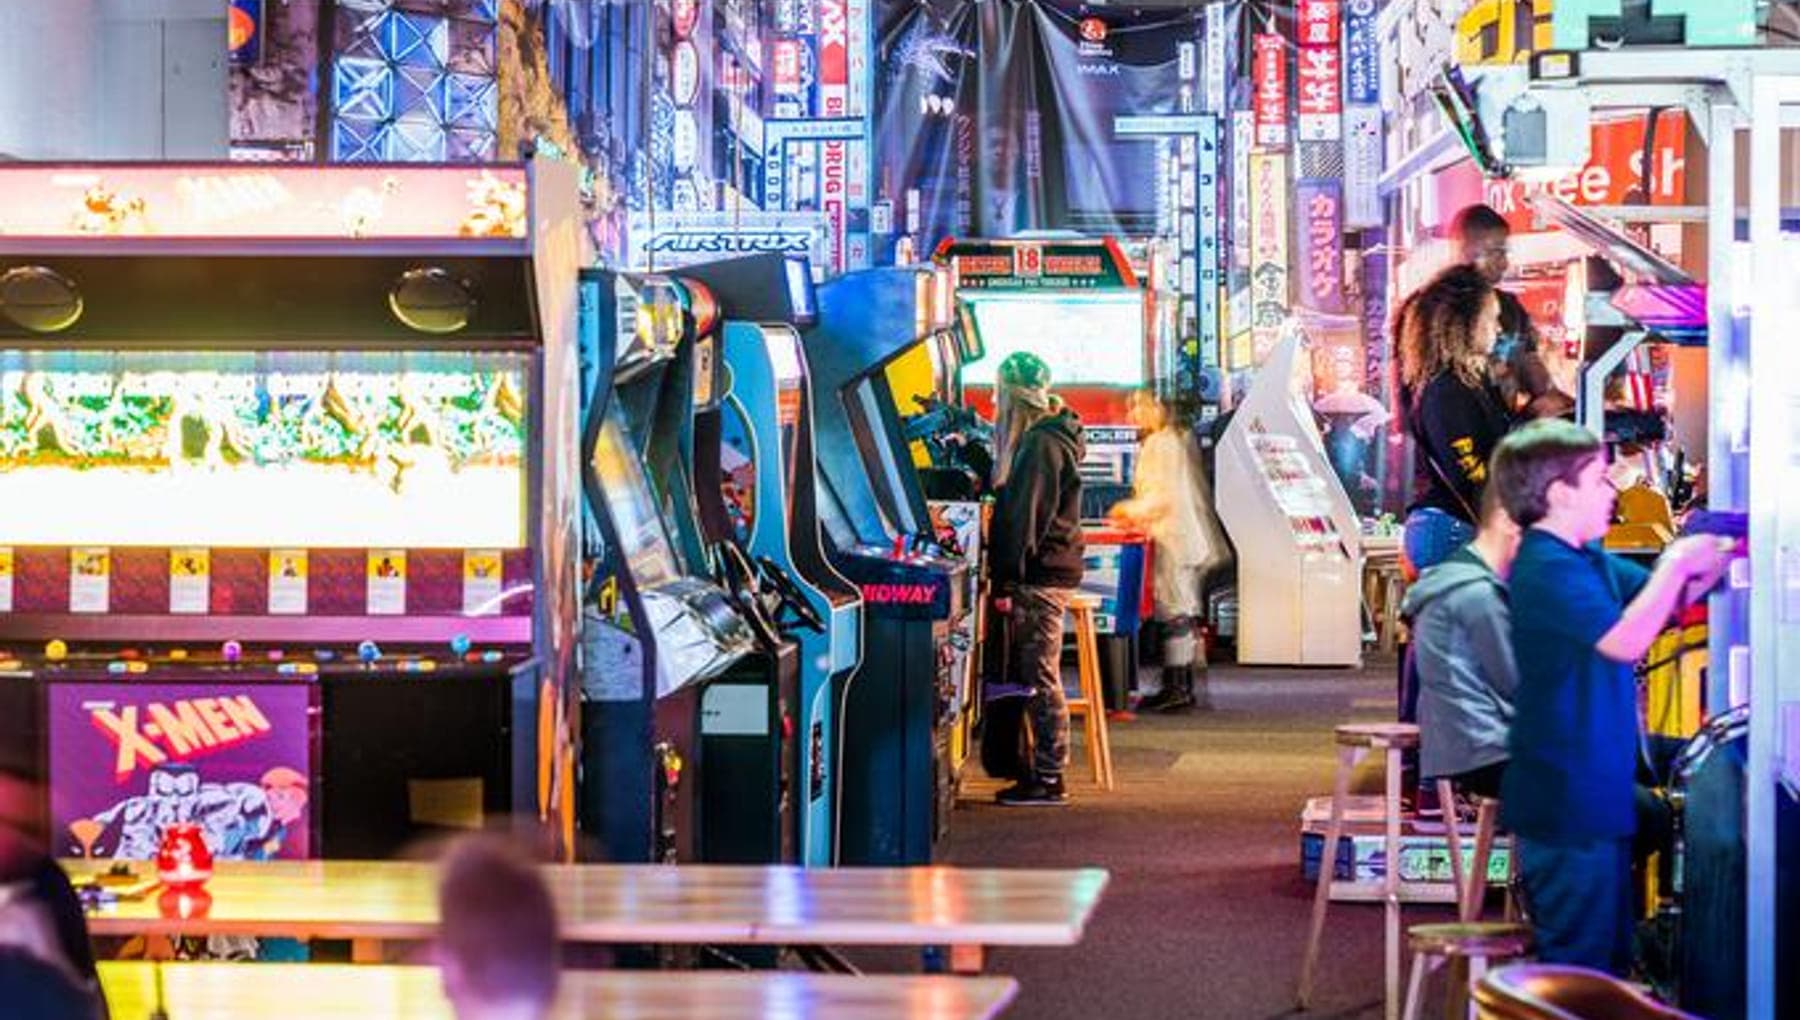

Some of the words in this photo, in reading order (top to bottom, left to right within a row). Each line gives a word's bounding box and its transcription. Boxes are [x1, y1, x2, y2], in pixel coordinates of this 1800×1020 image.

[1018, 249, 1039, 273] 18
[1310, 194, 1338, 298] カラオケ
[91, 695, 271, 778] X-MEN
